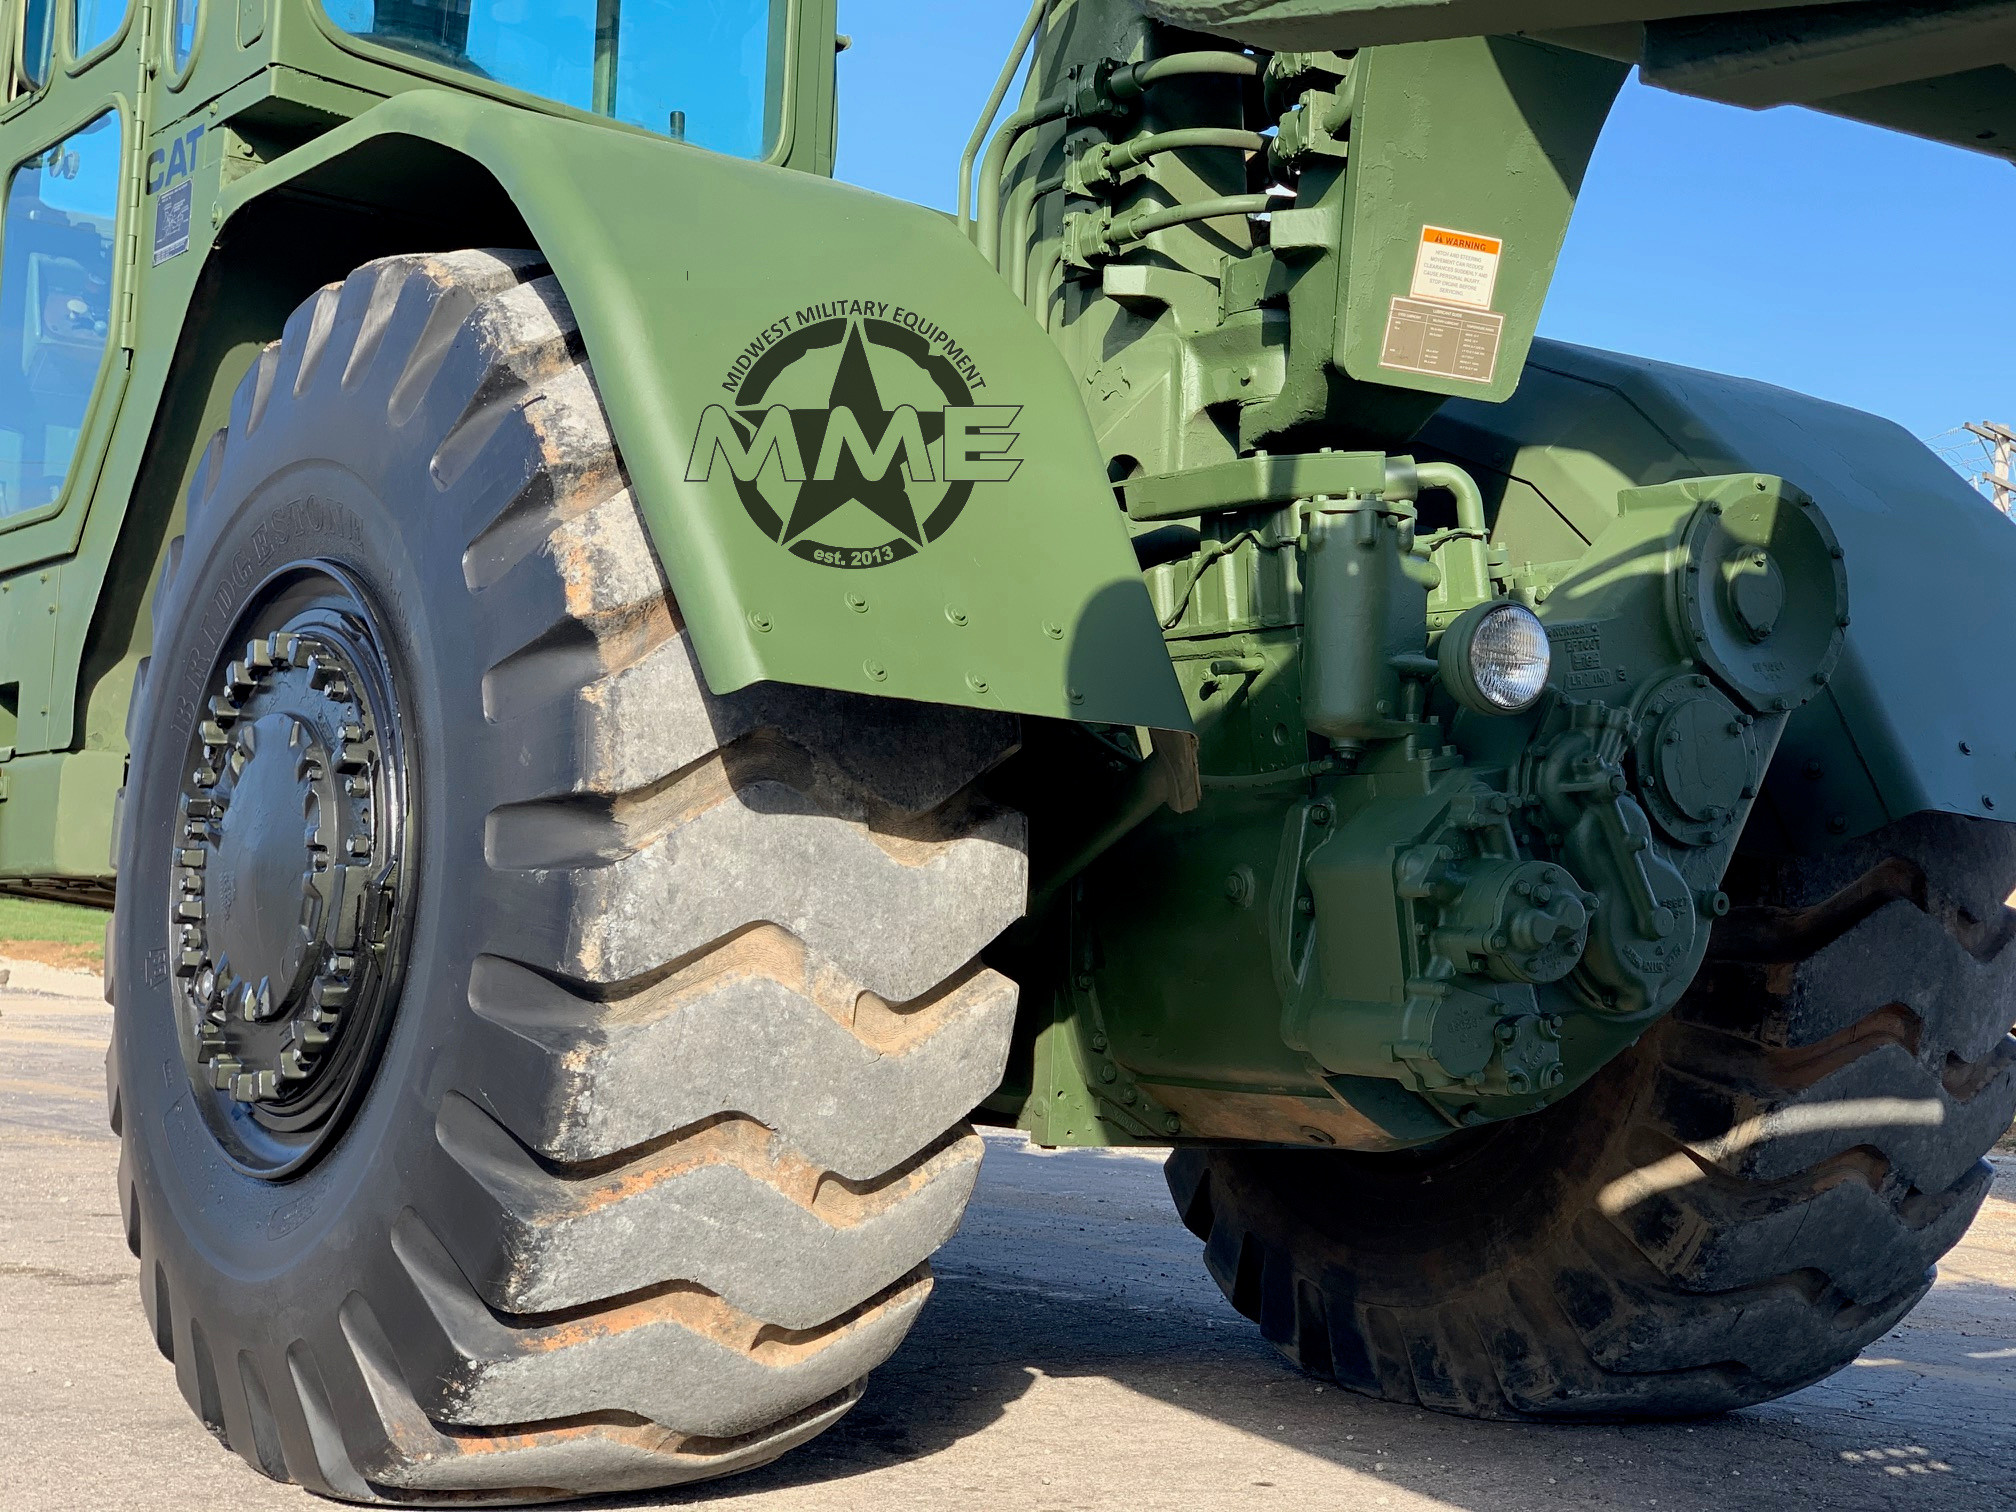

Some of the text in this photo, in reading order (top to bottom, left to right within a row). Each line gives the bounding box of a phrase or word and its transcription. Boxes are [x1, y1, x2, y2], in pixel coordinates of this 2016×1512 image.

[145, 123, 205, 195] CAT
[1445, 237, 1487, 252] WARNING
[1430, 256, 1455, 266] MOVEMENT
[1423, 262, 1454, 273] CLEARANCES
[1478, 271, 1488, 279] AND
[1423, 269, 1439, 278] CAUSE
[1439, 272, 1463, 282] PERSONAL
[170, 493, 366, 739] BRIDGESTONE
